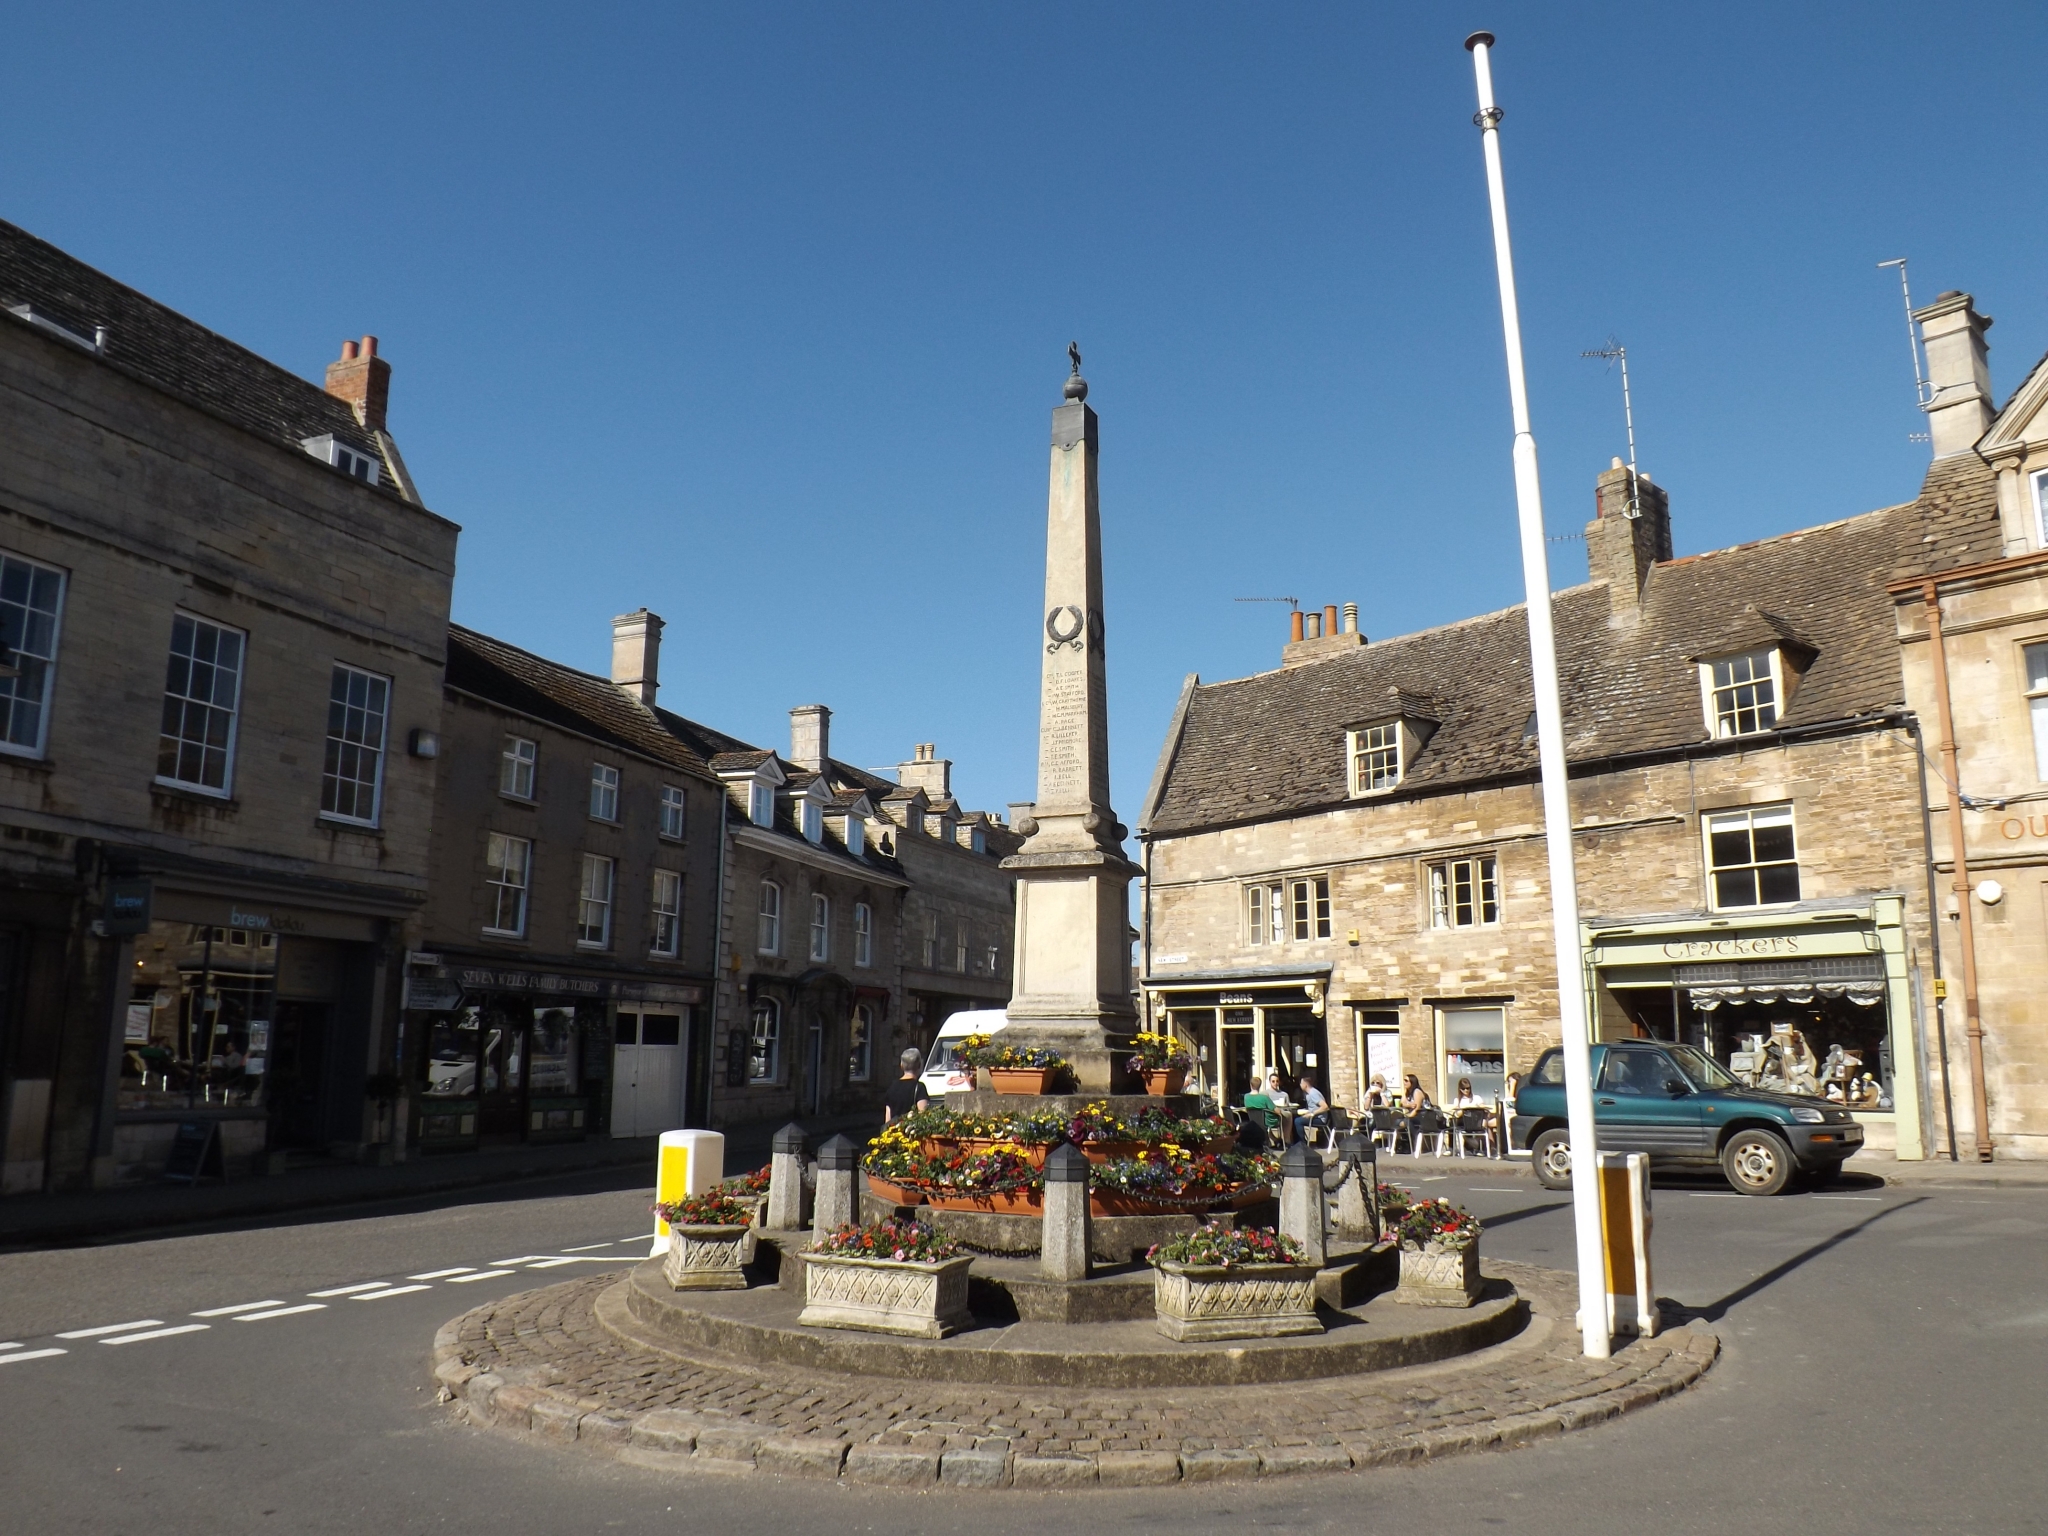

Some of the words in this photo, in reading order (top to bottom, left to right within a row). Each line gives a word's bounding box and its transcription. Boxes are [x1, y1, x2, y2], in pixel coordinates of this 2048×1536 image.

[115, 892, 144, 907] brew
[230, 905, 270, 928] brew
[1662, 932, 1799, 958] Crackers
[462, 971, 494, 984] SEVEN
[498, 973, 527, 987] WELLS
[528, 976, 558, 990] FAMILY
[559, 978, 599, 993] BUTCHERS
[1220, 992, 1253, 1004] Beans
